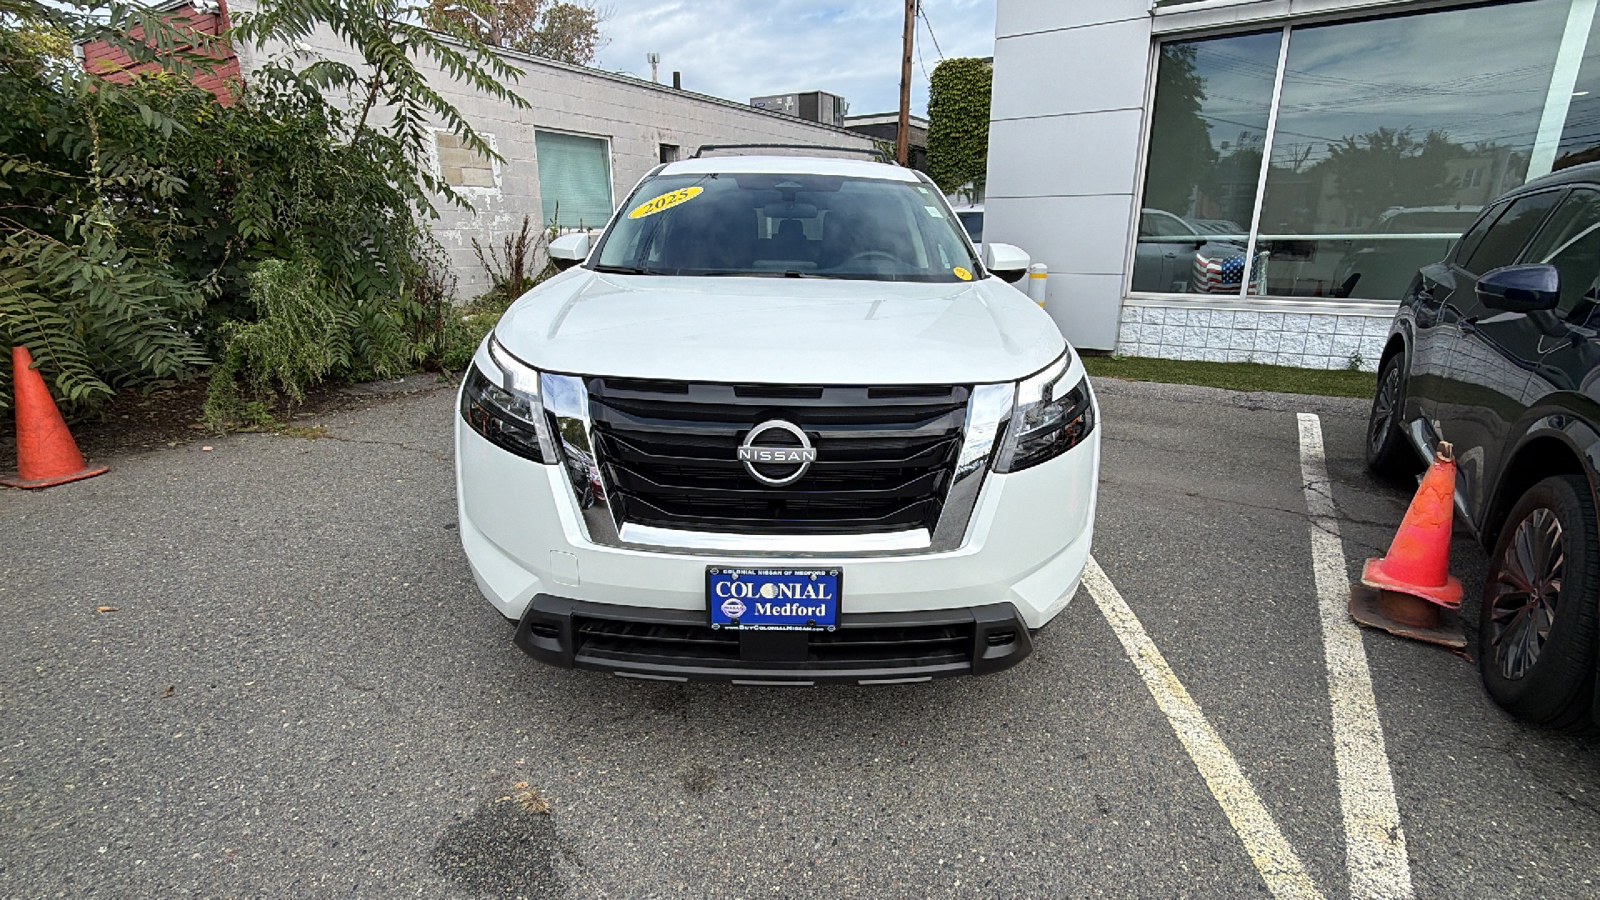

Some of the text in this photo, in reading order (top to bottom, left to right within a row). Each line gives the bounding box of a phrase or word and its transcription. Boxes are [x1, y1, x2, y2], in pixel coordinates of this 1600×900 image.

[643, 189, 688, 214] 2025
[739, 449, 815, 461] NISSAN
[716, 581, 832, 599] COLONIAL
[755, 603, 826, 616] Medford
